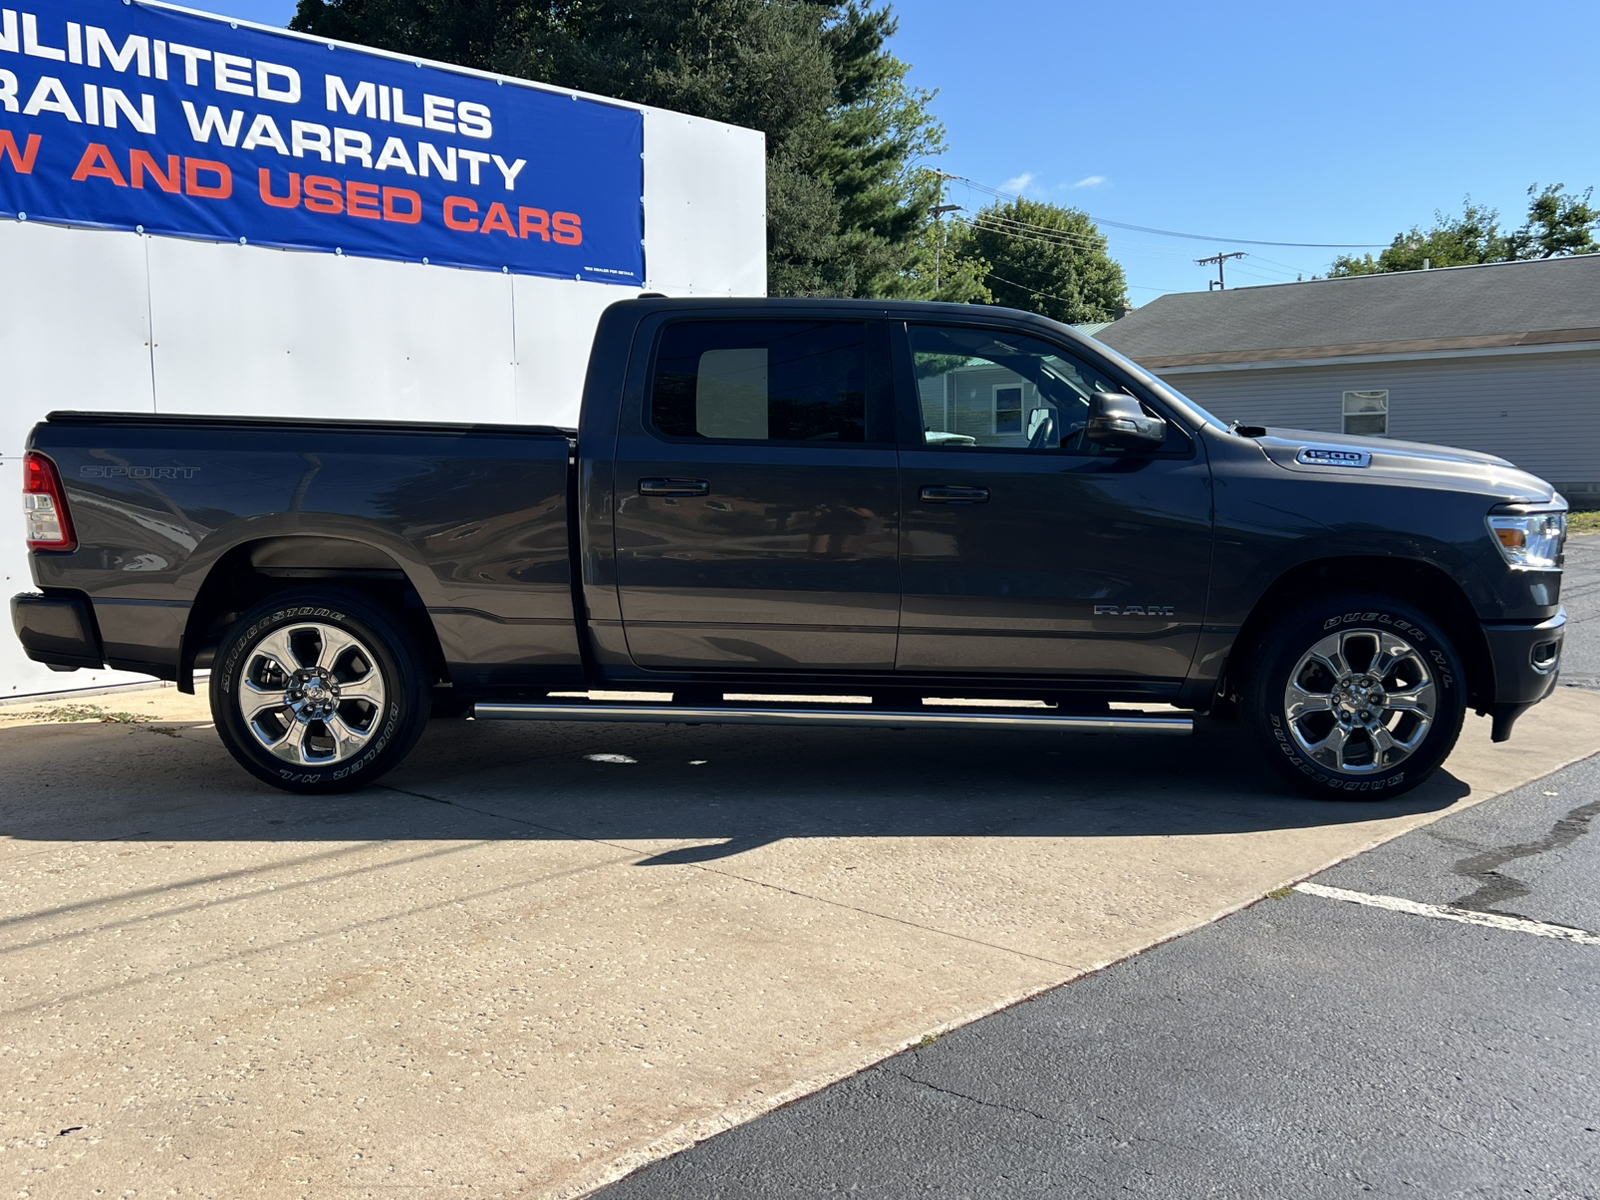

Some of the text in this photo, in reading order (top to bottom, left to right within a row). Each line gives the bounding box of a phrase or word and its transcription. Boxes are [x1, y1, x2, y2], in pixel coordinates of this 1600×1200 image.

[326, 74, 493, 139] MILES
[182, 101, 527, 191] WARRANTY
[72, 143, 233, 199] AND
[259, 168, 423, 225] USED
[444, 196, 583, 246] CARS
[80, 465, 201, 479] SPORT
[1309, 450, 1360, 460] 1500
[1093, 605, 1175, 616] RAM
[220, 606, 346, 694] BRIDGESTONE
[1323, 612, 1453, 688] DUELER H/L
[279, 701, 400, 784] DUELER H/L
[1270, 713, 1405, 791] BRIDGESTONE
